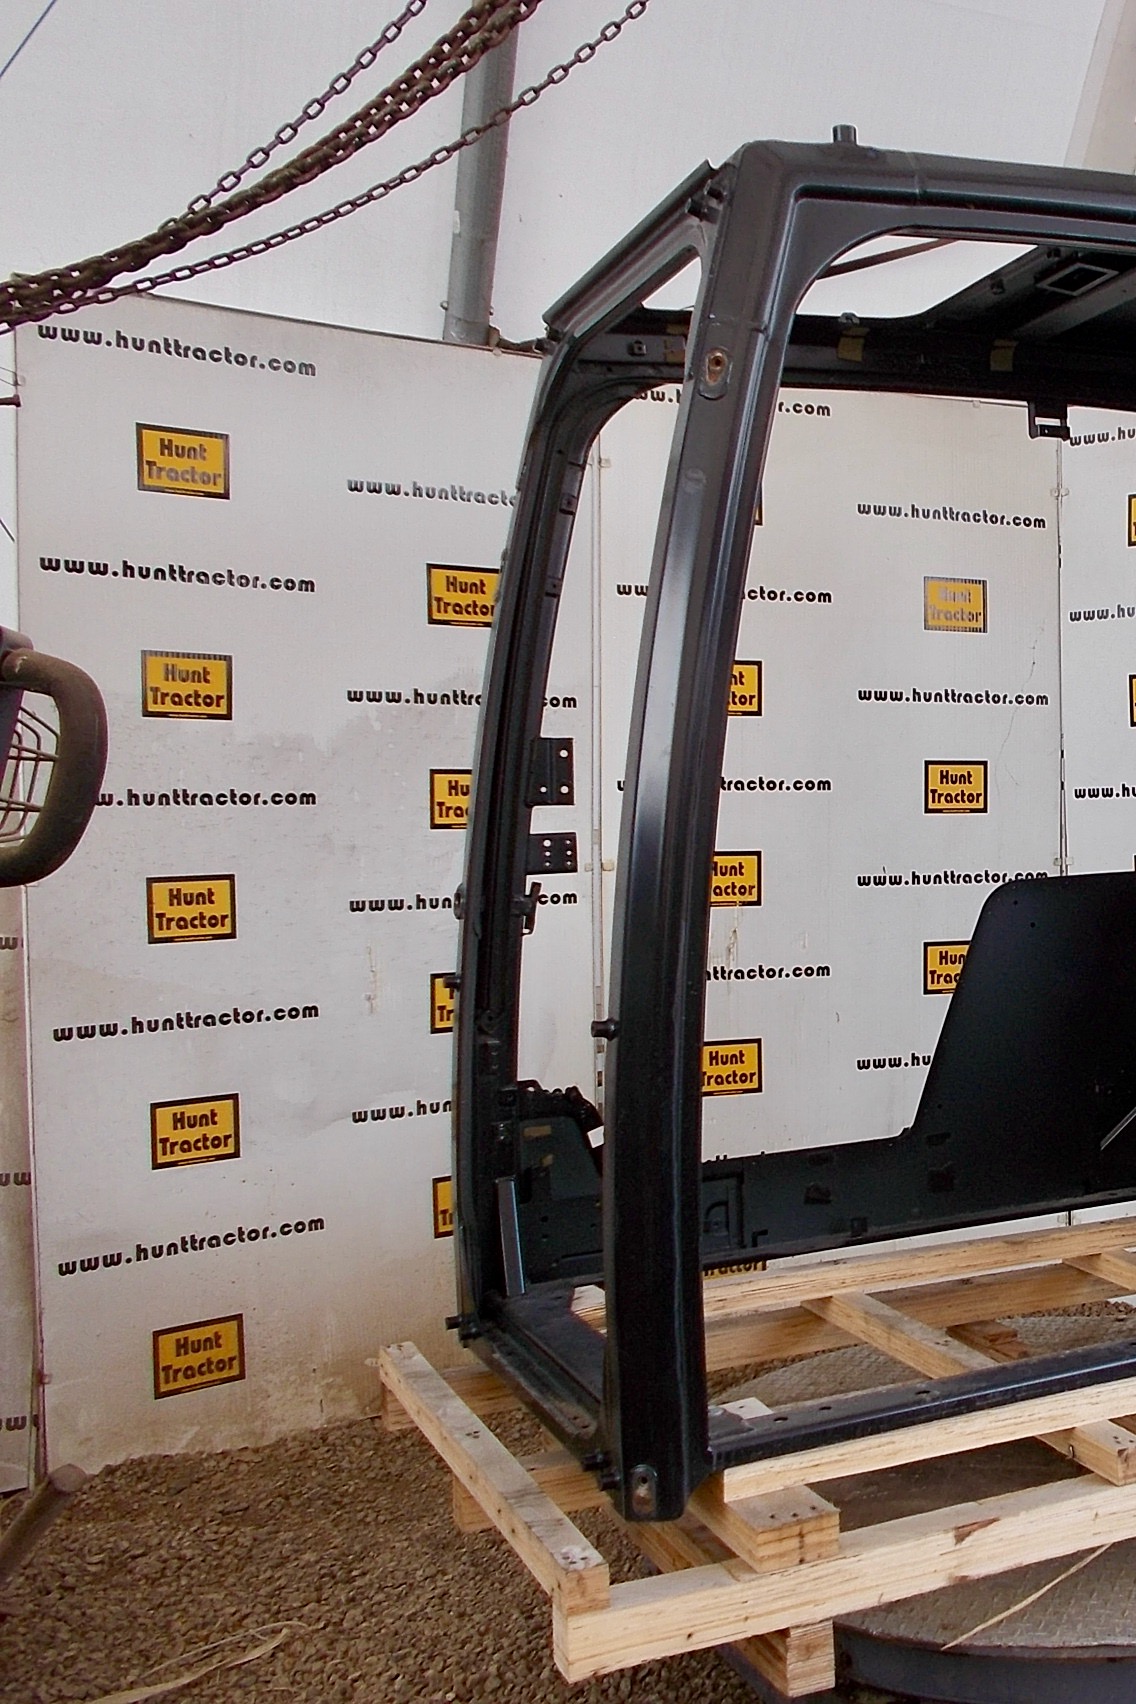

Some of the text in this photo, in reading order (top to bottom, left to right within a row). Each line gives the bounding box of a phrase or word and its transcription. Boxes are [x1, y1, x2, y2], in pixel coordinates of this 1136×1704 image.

[37, 323, 317, 377] www.hunttractor.com
[160, 438, 207, 459] Hunt
[145, 460, 221, 486] Tractor
[346, 477, 514, 507] www.hunttract
[858, 504, 1045, 528] www.hunttractor.com
[40, 558, 314, 592] www.hunttractor.com
[446, 576, 486, 594] Hunt
[165, 664, 210, 684] Hunt
[150, 687, 224, 707] Tractor
[858, 688, 1048, 705] www.hunttractor.com
[940, 770, 972, 784] Hunt
[96, 788, 317, 807] w.hunttractor.com
[930, 789, 982, 804] Tractor
[169, 888, 215, 906] Hunt
[712, 881, 757, 897] actor
[156, 912, 229, 931] Tractor
[938, 950, 967, 966] Hun
[53, 1006, 318, 1041] www.hunttractor.com
[709, 1050, 745, 1066] Hunt
[173, 1109, 217, 1130] Hunt
[159, 1133, 232, 1156] Tractor
[58, 1218, 324, 1276] www.hunttractor.com
[175, 1331, 222, 1357] Hunt
[161, 1356, 237, 1384] Tractor
